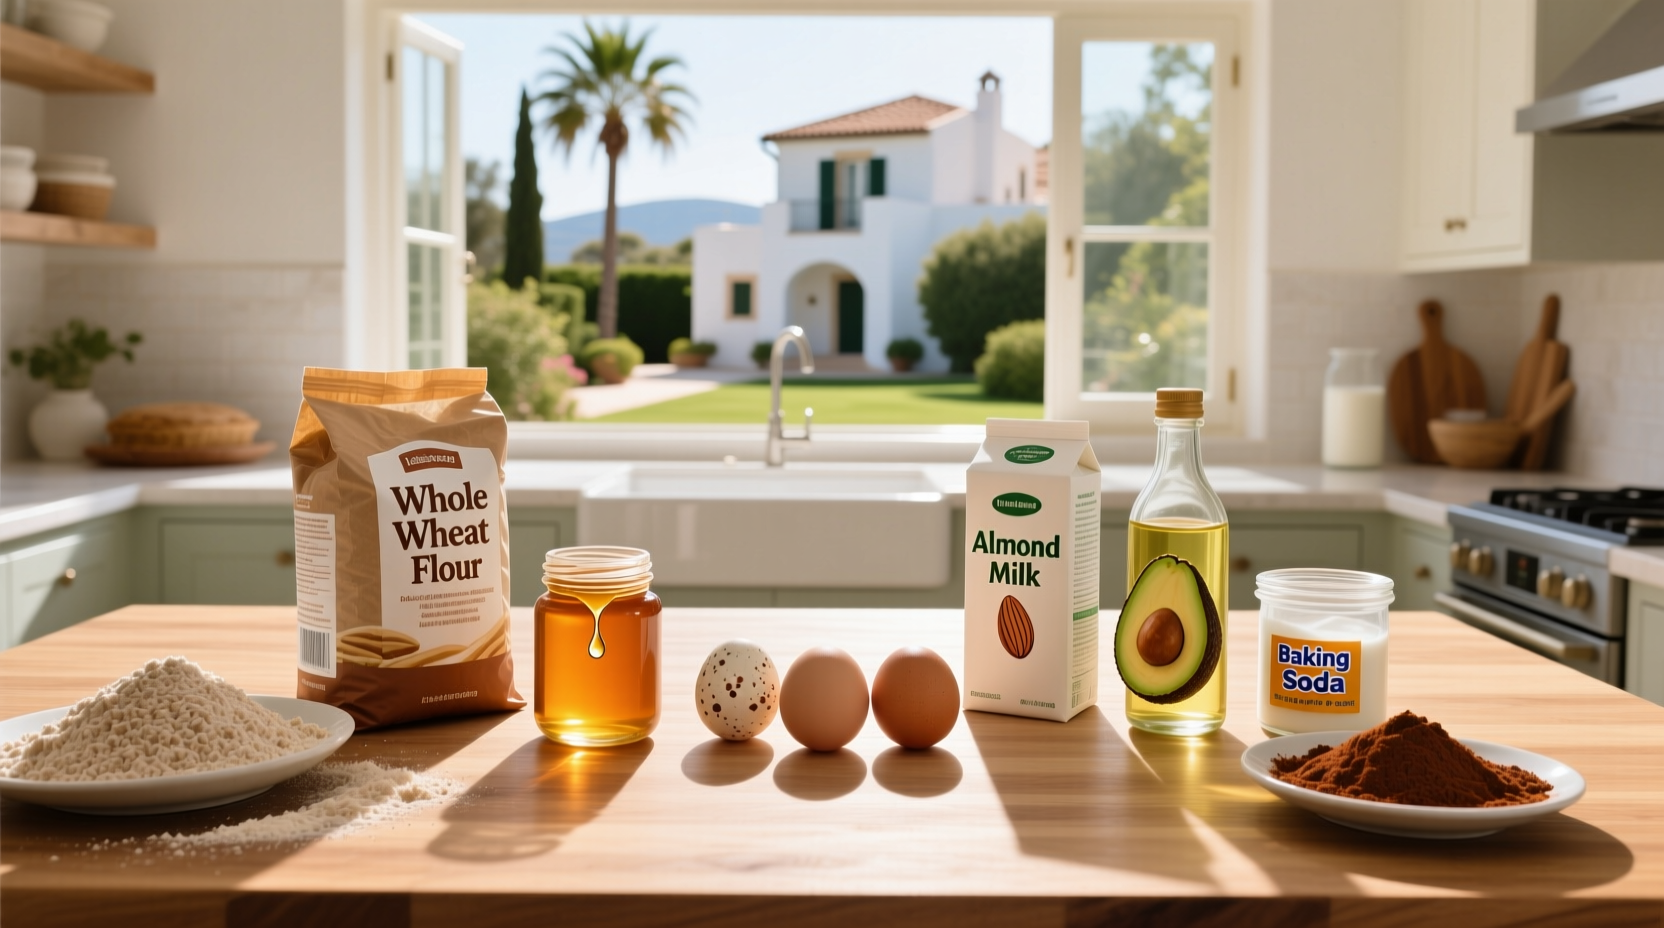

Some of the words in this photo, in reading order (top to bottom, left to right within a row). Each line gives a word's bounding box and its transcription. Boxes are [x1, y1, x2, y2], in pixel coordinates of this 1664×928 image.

[389, 481, 488, 516] Whole
[392, 518, 490, 551] Wheat
[972, 530, 1060, 558] Almond
[411, 554, 483, 584] Flour
[989, 561, 1041, 587] Milk
[1278, 643, 1351, 672] Baking
[1282, 668, 1346, 694] Soda
